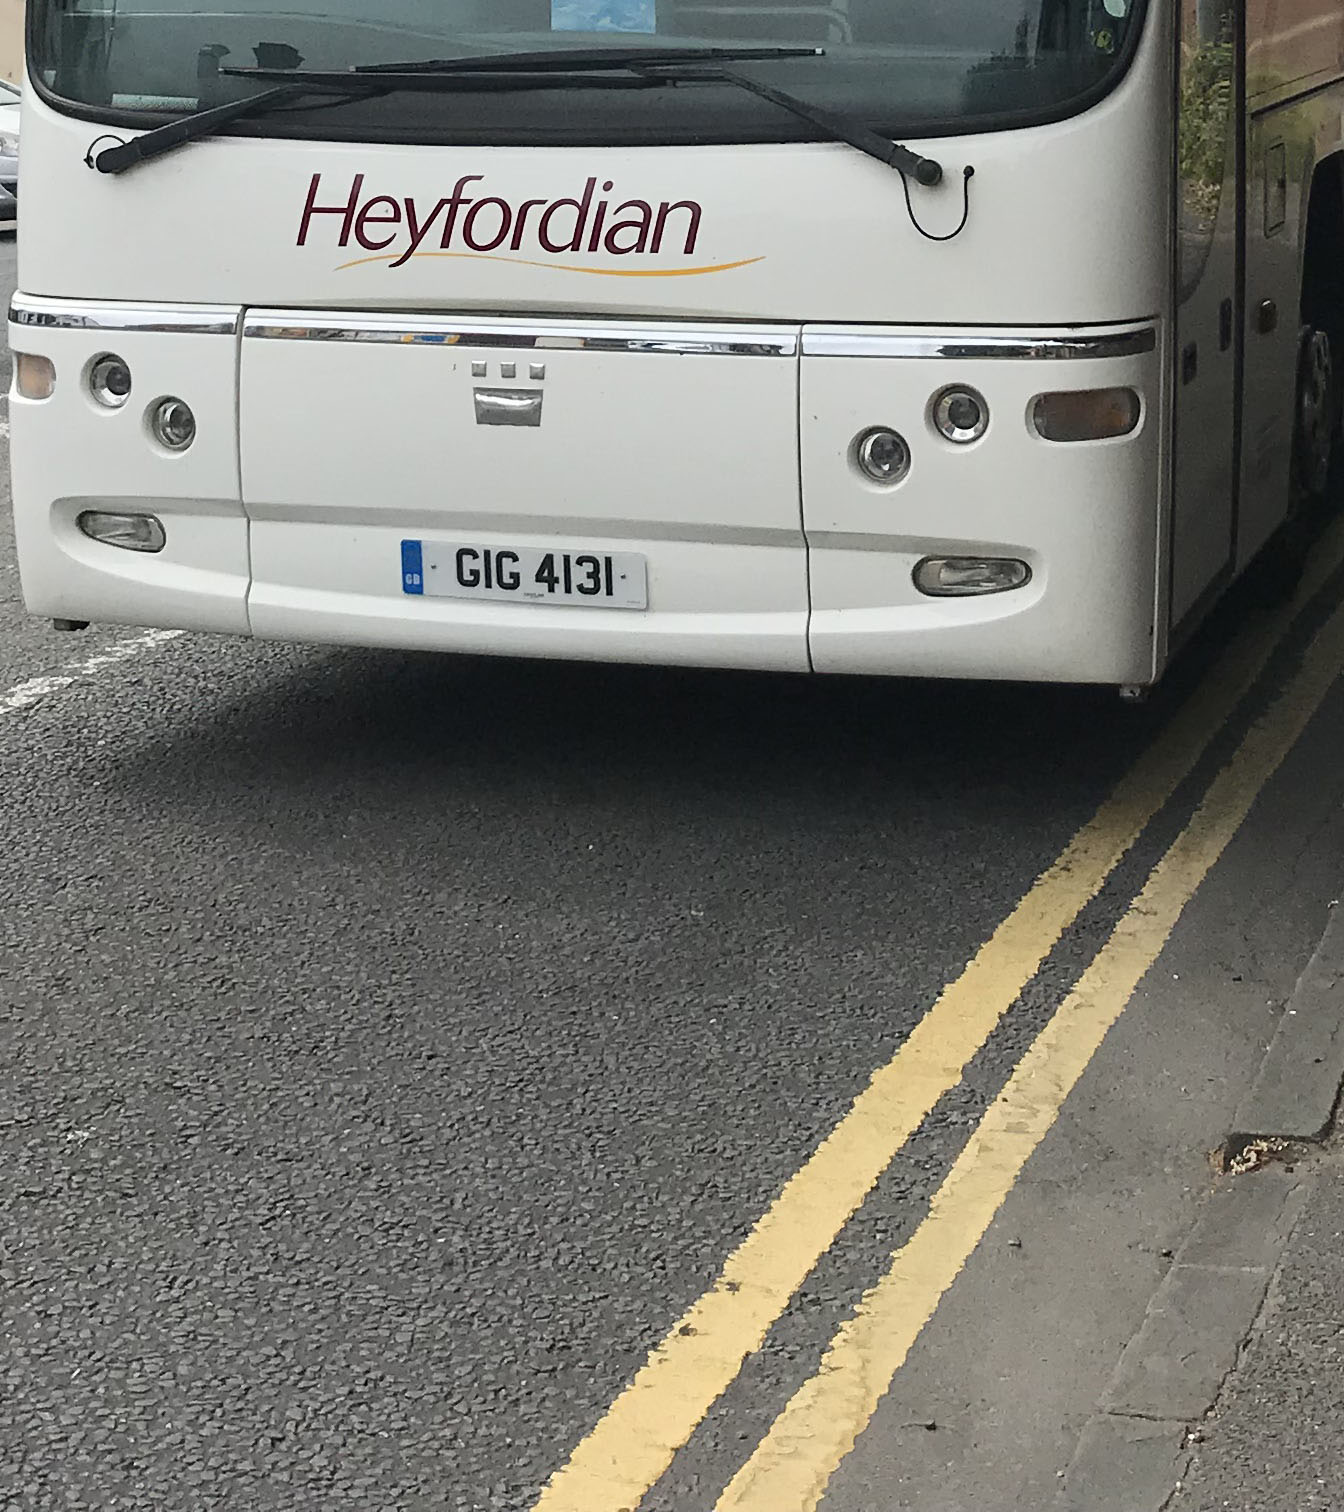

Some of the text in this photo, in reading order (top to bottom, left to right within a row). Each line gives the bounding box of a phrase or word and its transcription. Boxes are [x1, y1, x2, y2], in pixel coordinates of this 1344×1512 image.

[295, 173, 703, 268] Heyfordian
[456, 547, 614, 597] GIG 4131
